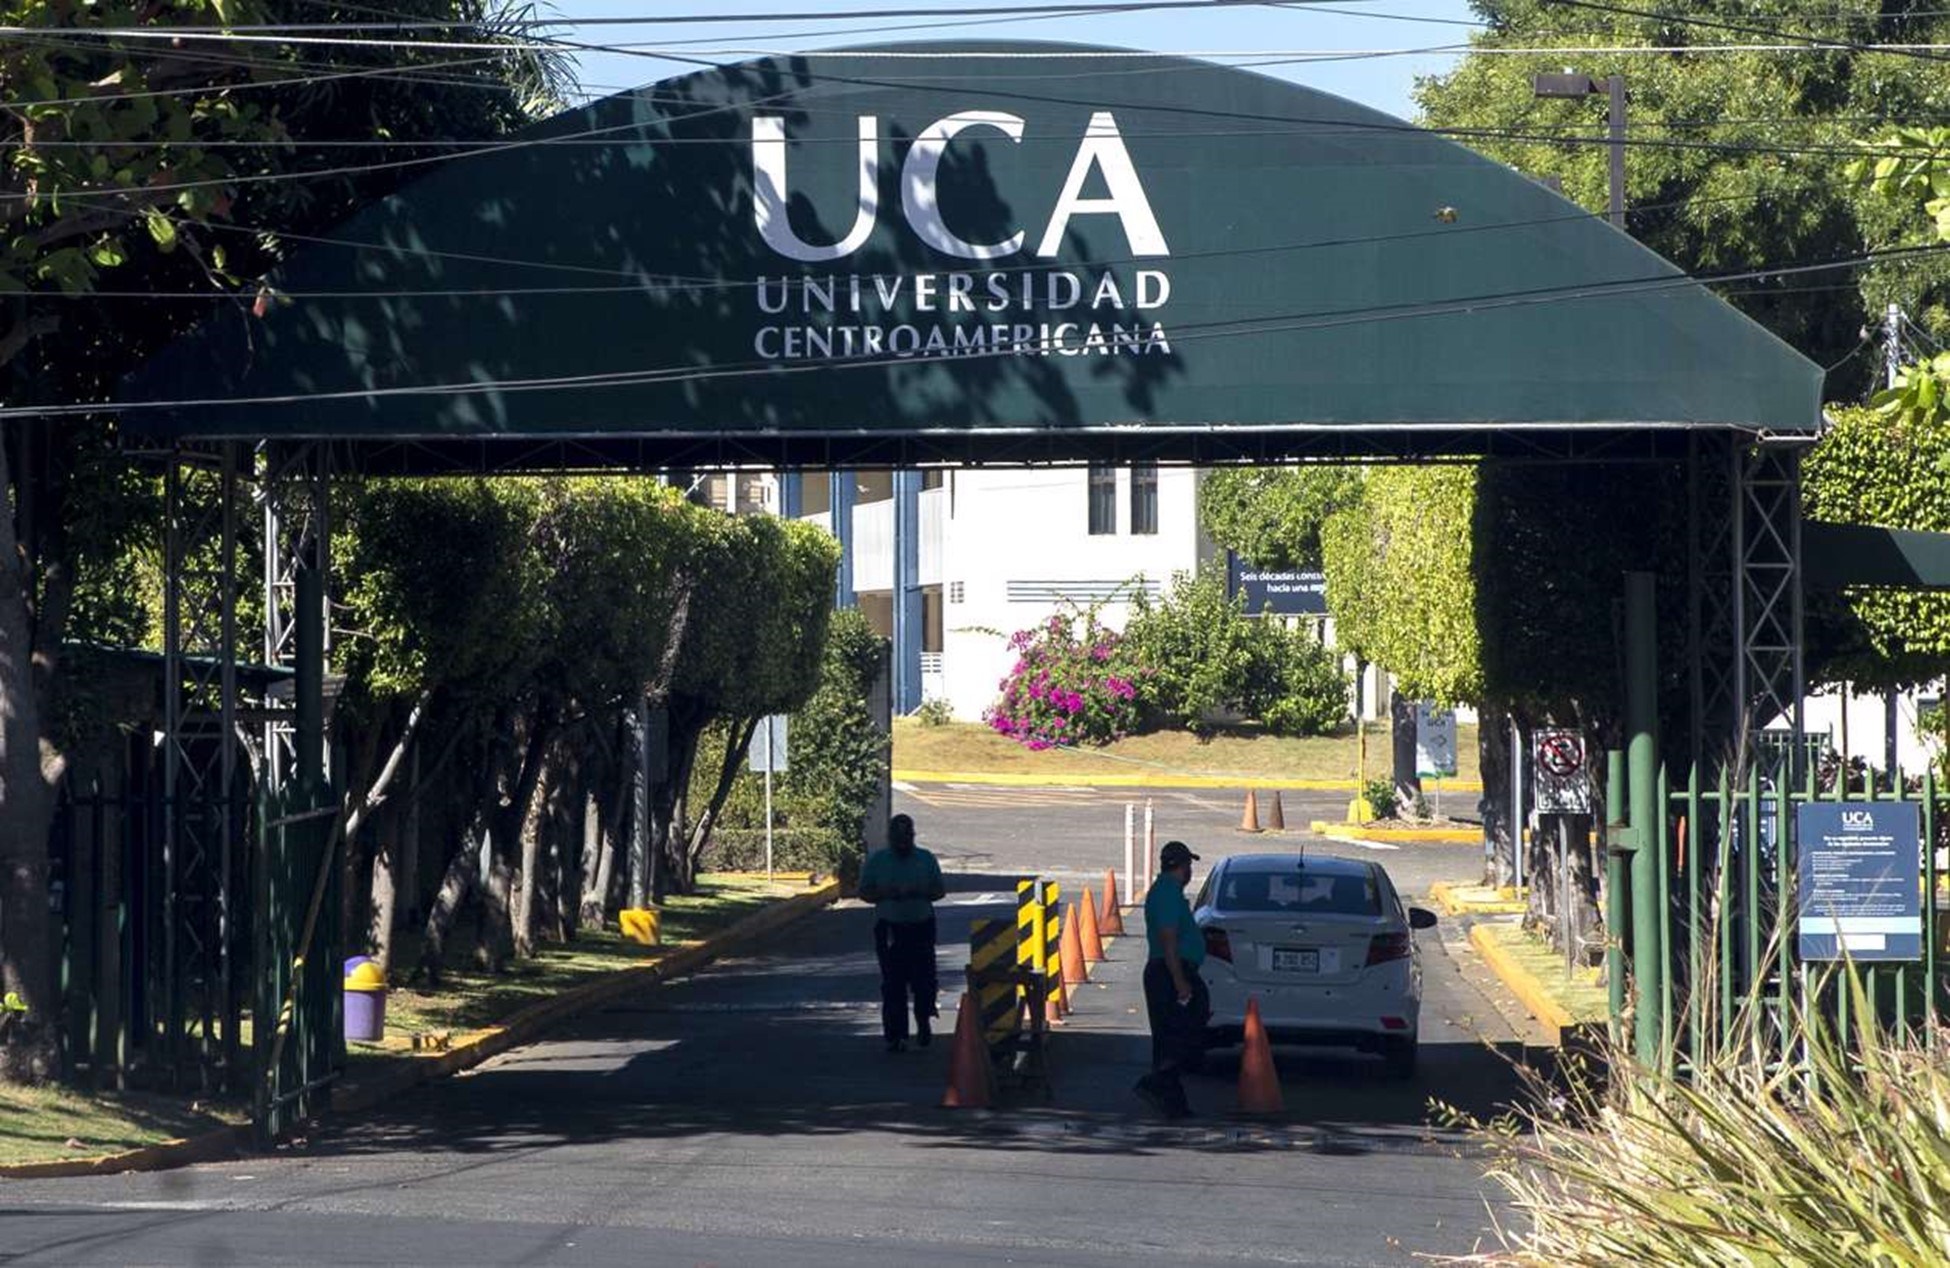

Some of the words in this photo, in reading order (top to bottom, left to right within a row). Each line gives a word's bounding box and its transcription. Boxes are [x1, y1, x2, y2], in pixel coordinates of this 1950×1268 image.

[751, 110, 1171, 262] UCA
[757, 271, 1171, 314] UNIVERSIDAD
[755, 322, 1171, 359] CENTROAMERICANA
[1240, 572, 1257, 581] Seis
[1267, 583, 1291, 592] hacia
[1842, 811, 1873, 824] UCA
